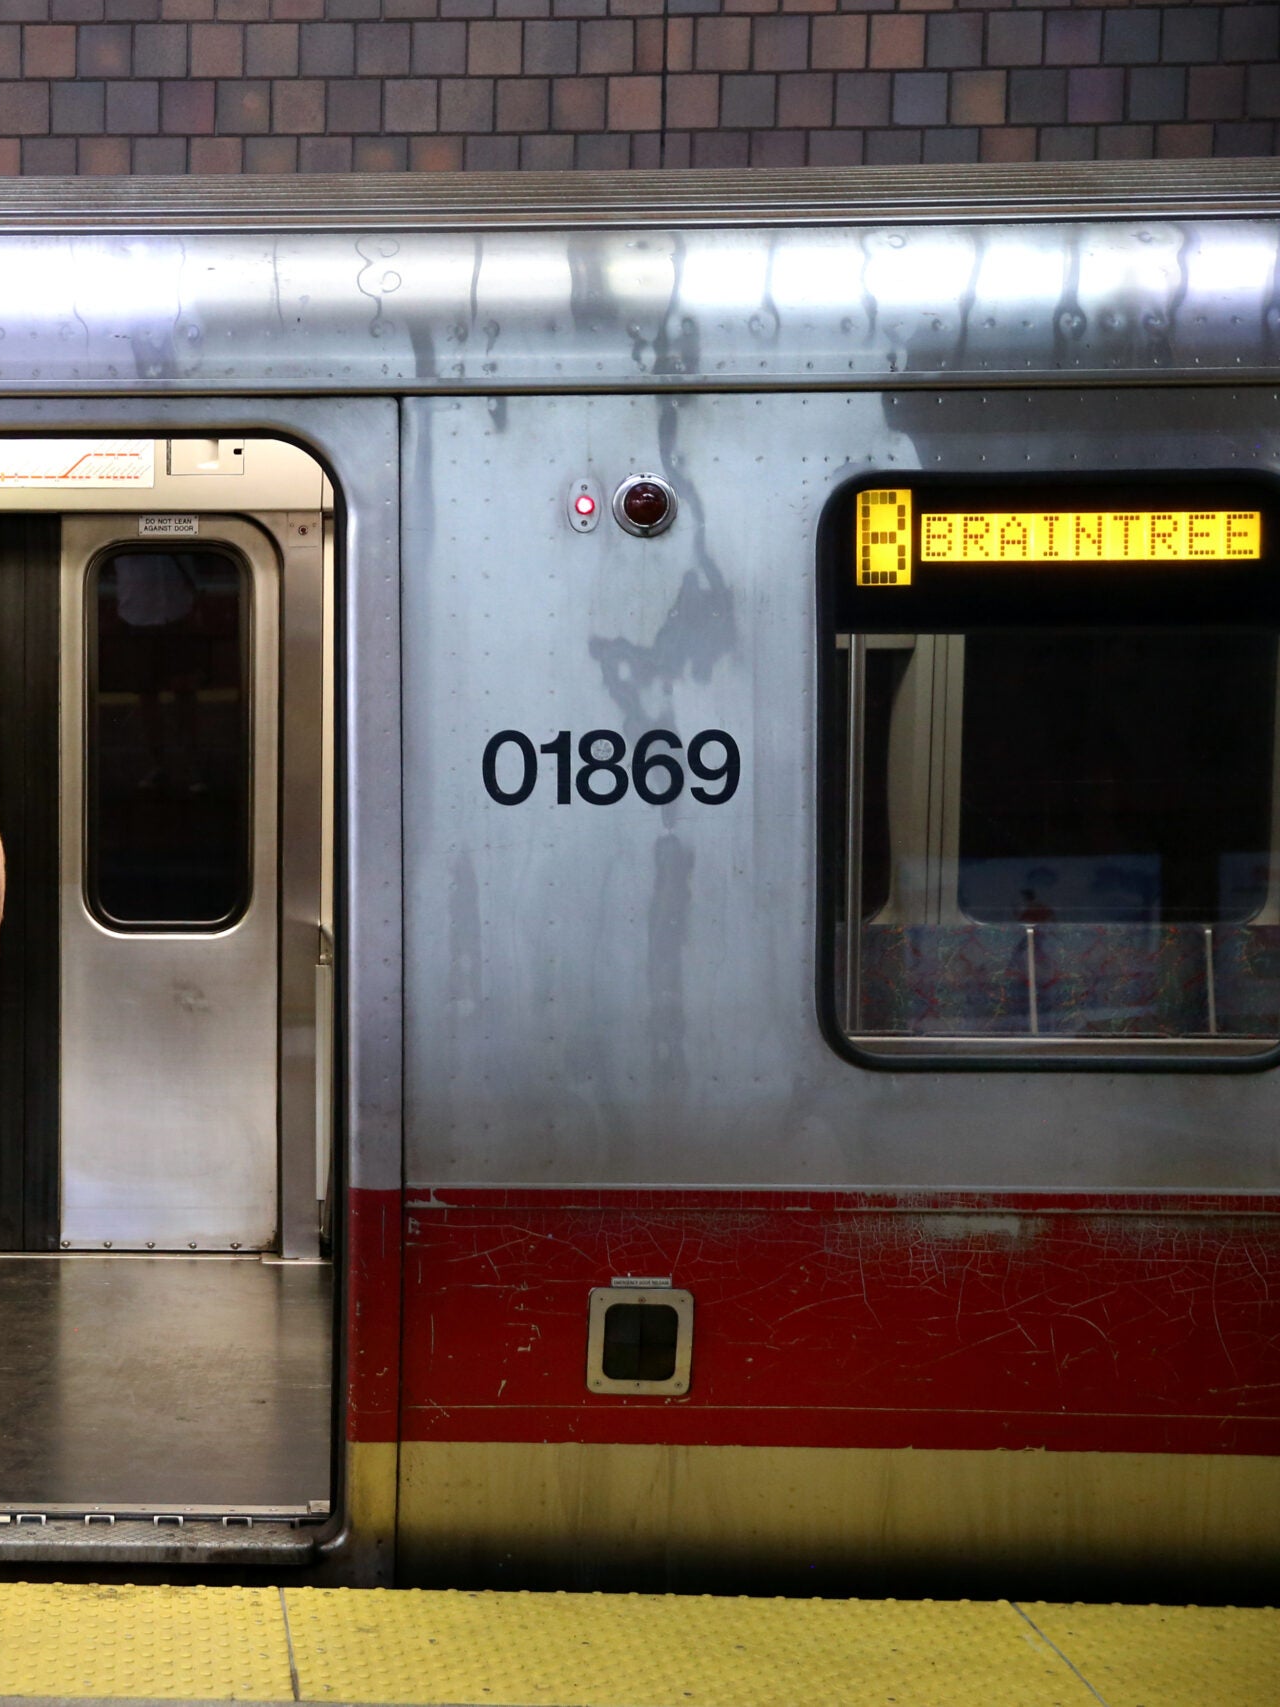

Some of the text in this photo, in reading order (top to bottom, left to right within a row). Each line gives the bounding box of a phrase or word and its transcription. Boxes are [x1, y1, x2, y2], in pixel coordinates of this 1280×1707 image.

[861, 491, 1255, 585] B BRAINTREE
[481, 728, 741, 806] 01869
